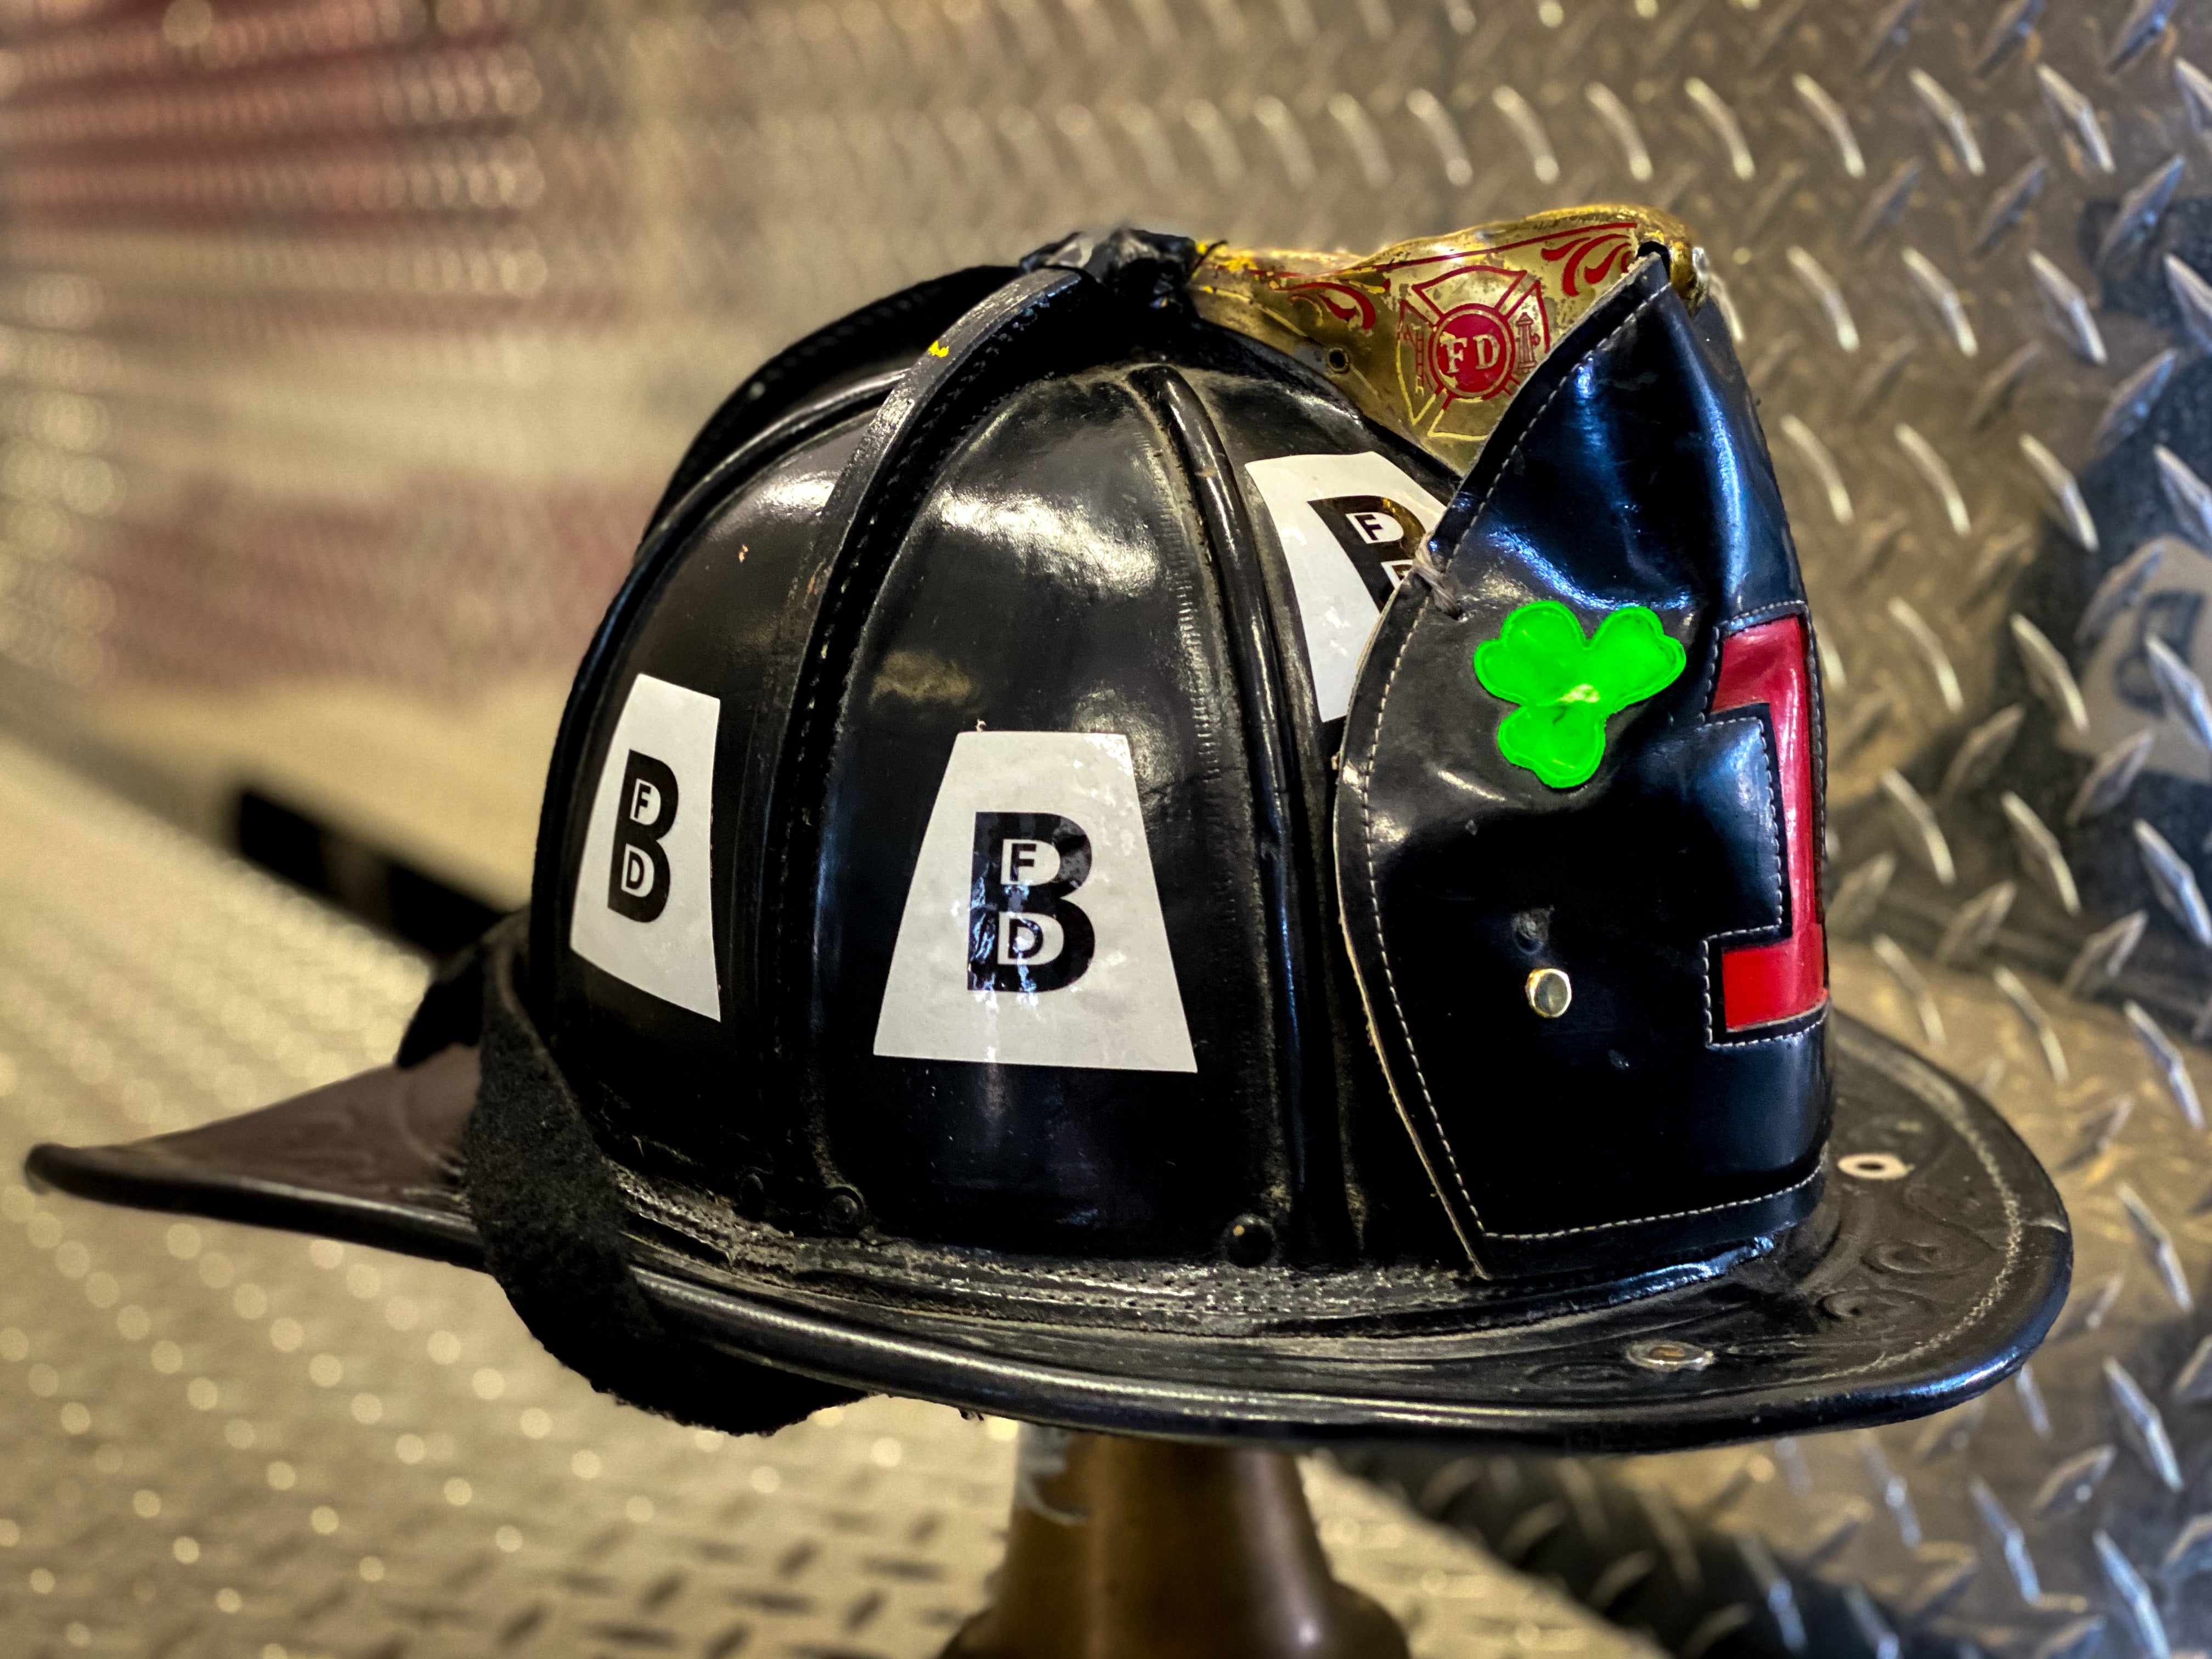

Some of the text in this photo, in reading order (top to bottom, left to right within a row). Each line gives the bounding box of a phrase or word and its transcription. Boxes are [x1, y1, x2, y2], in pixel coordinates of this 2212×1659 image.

[1440, 332, 1500, 373] FD
[1355, 514, 1384, 540] F
[634, 783, 651, 819] F
[607, 749, 679, 923] B
[626, 851, 644, 889] D
[1011, 843, 1037, 882] F
[967, 812, 1096, 993] B
[1007, 917, 1043, 960] D
